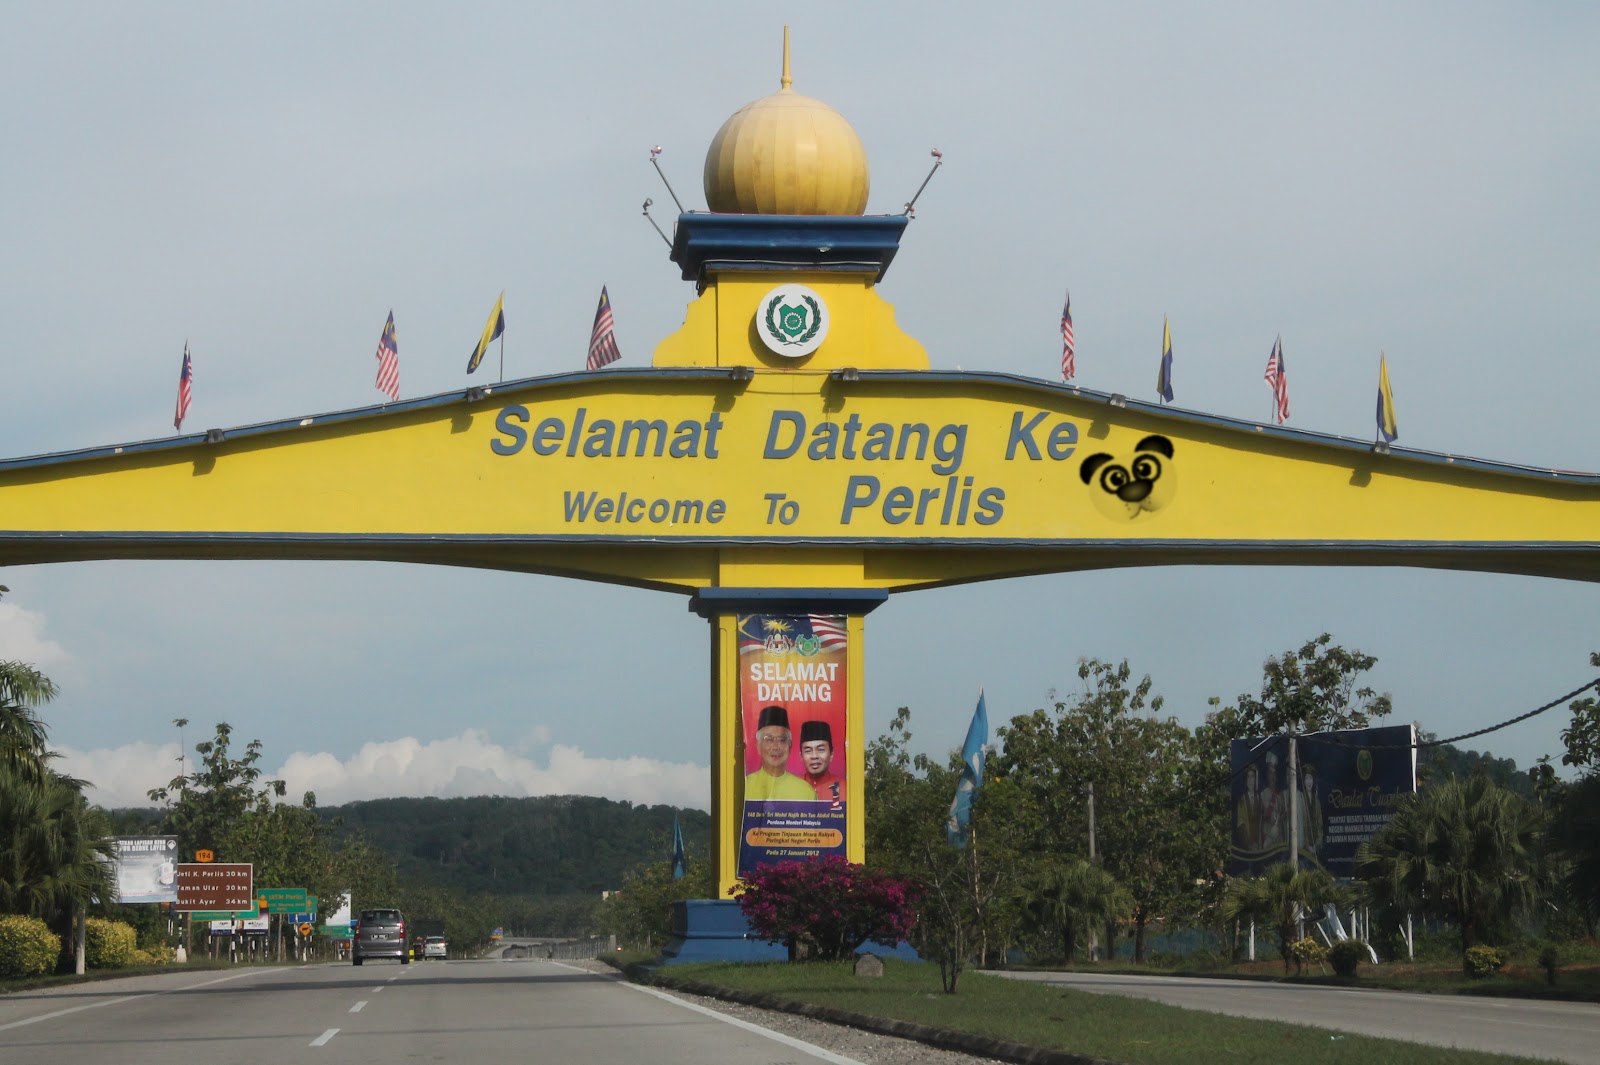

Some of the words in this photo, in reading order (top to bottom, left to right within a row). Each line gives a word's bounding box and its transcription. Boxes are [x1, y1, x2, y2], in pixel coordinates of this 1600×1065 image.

[490, 405, 724, 460] Selamat
[763, 410, 969, 475] Datang
[1004, 411, 1079, 461] Ke
[562, 490, 726, 524] Welcome
[764, 493, 800, 525] To
[840, 475, 1006, 526] Perlis
[750, 662, 838, 682] SELAMAT
[758, 683, 832, 702] DATANG
